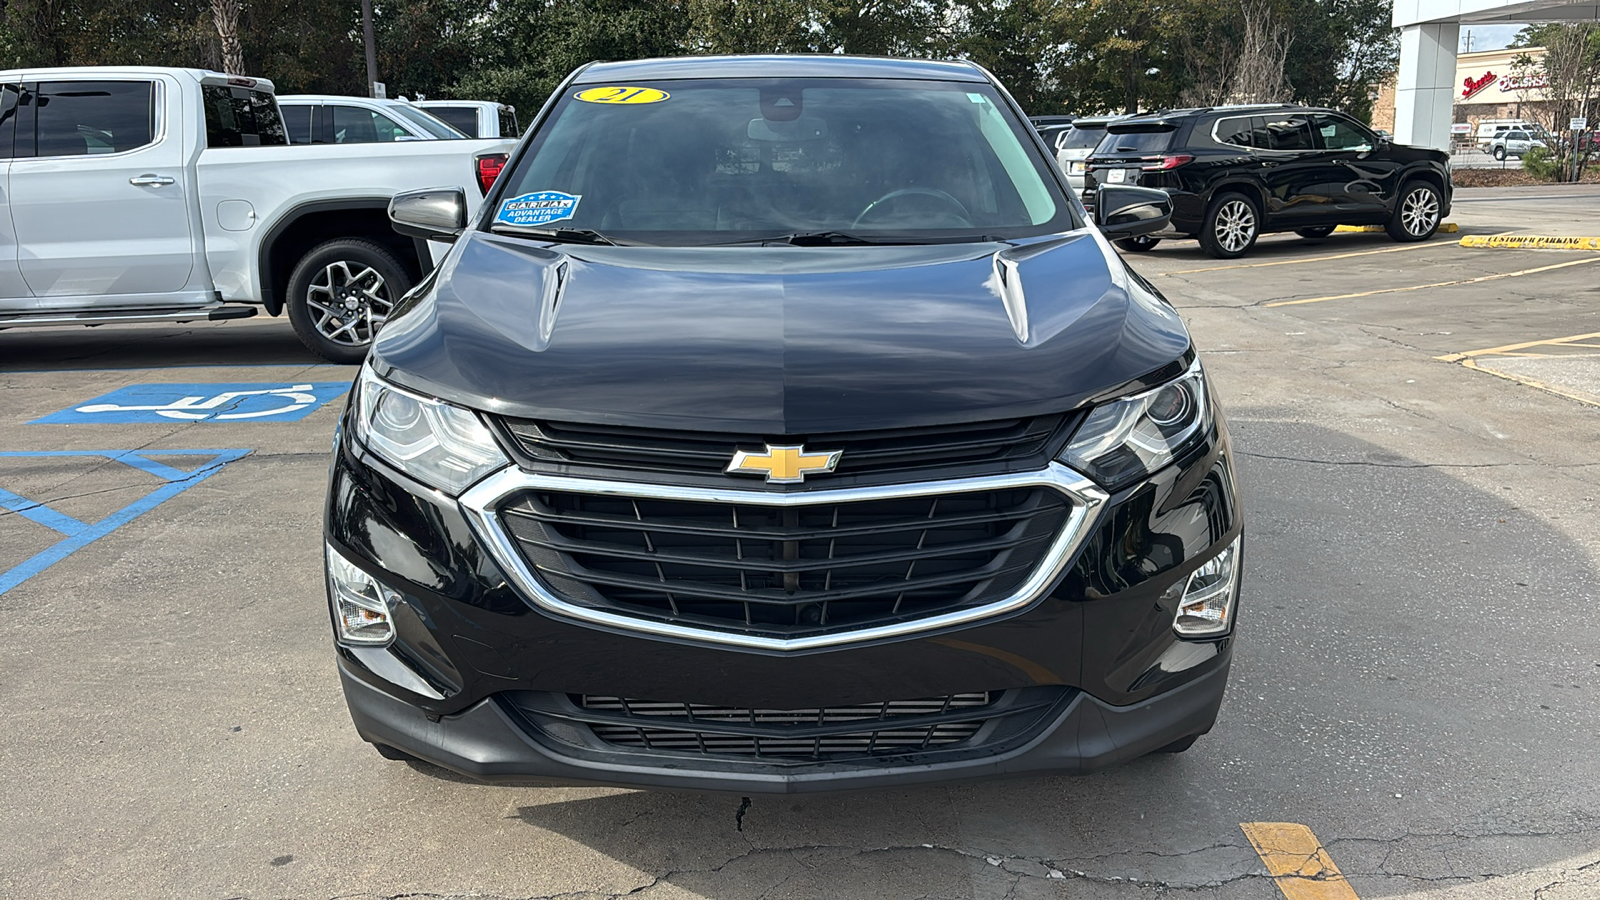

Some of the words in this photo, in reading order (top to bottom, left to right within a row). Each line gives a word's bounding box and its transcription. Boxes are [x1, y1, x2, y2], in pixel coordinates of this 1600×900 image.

[594, 88, 647, 101] 21
[506, 200, 573, 210] CARFAX
[507, 208, 564, 217] ADVANTAGE
[514, 215, 552, 223] DEALER
